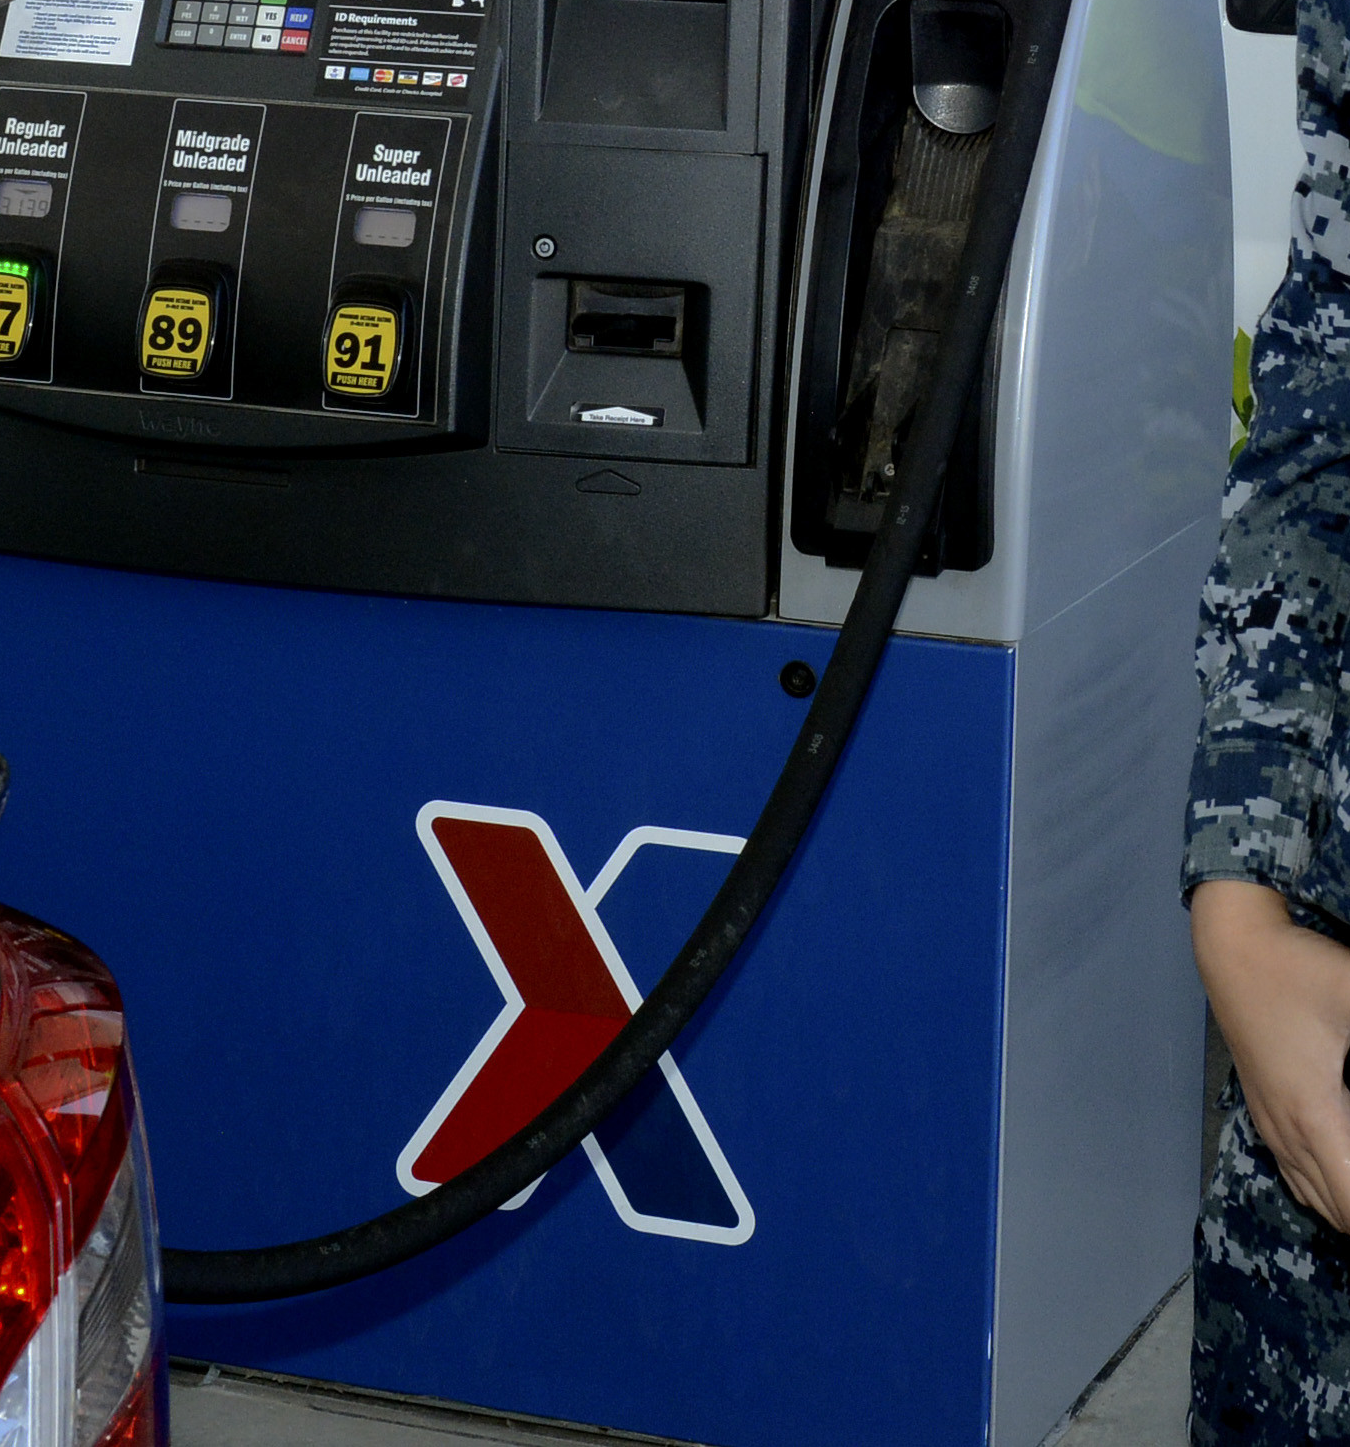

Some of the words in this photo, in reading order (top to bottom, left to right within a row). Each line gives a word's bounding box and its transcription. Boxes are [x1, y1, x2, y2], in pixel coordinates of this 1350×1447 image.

[265, 12, 277, 21] YES
[290, 13, 308, 22] HELP
[335, 12, 348, 22] ID
[348, 14, 418, 26] Requirements
[261, 34, 271, 42] NO
[281, 35, 308, 46] CANCEL
[5, 118, 65, 138] Regular
[176, 130, 250, 153] Midgrade
[173, 150, 247, 172] Unleaded
[373, 144, 420, 165] Super
[355, 164, 431, 186] Unleaded
[148, 315, 203, 353] 89
[334, 332, 386, 372] 91
